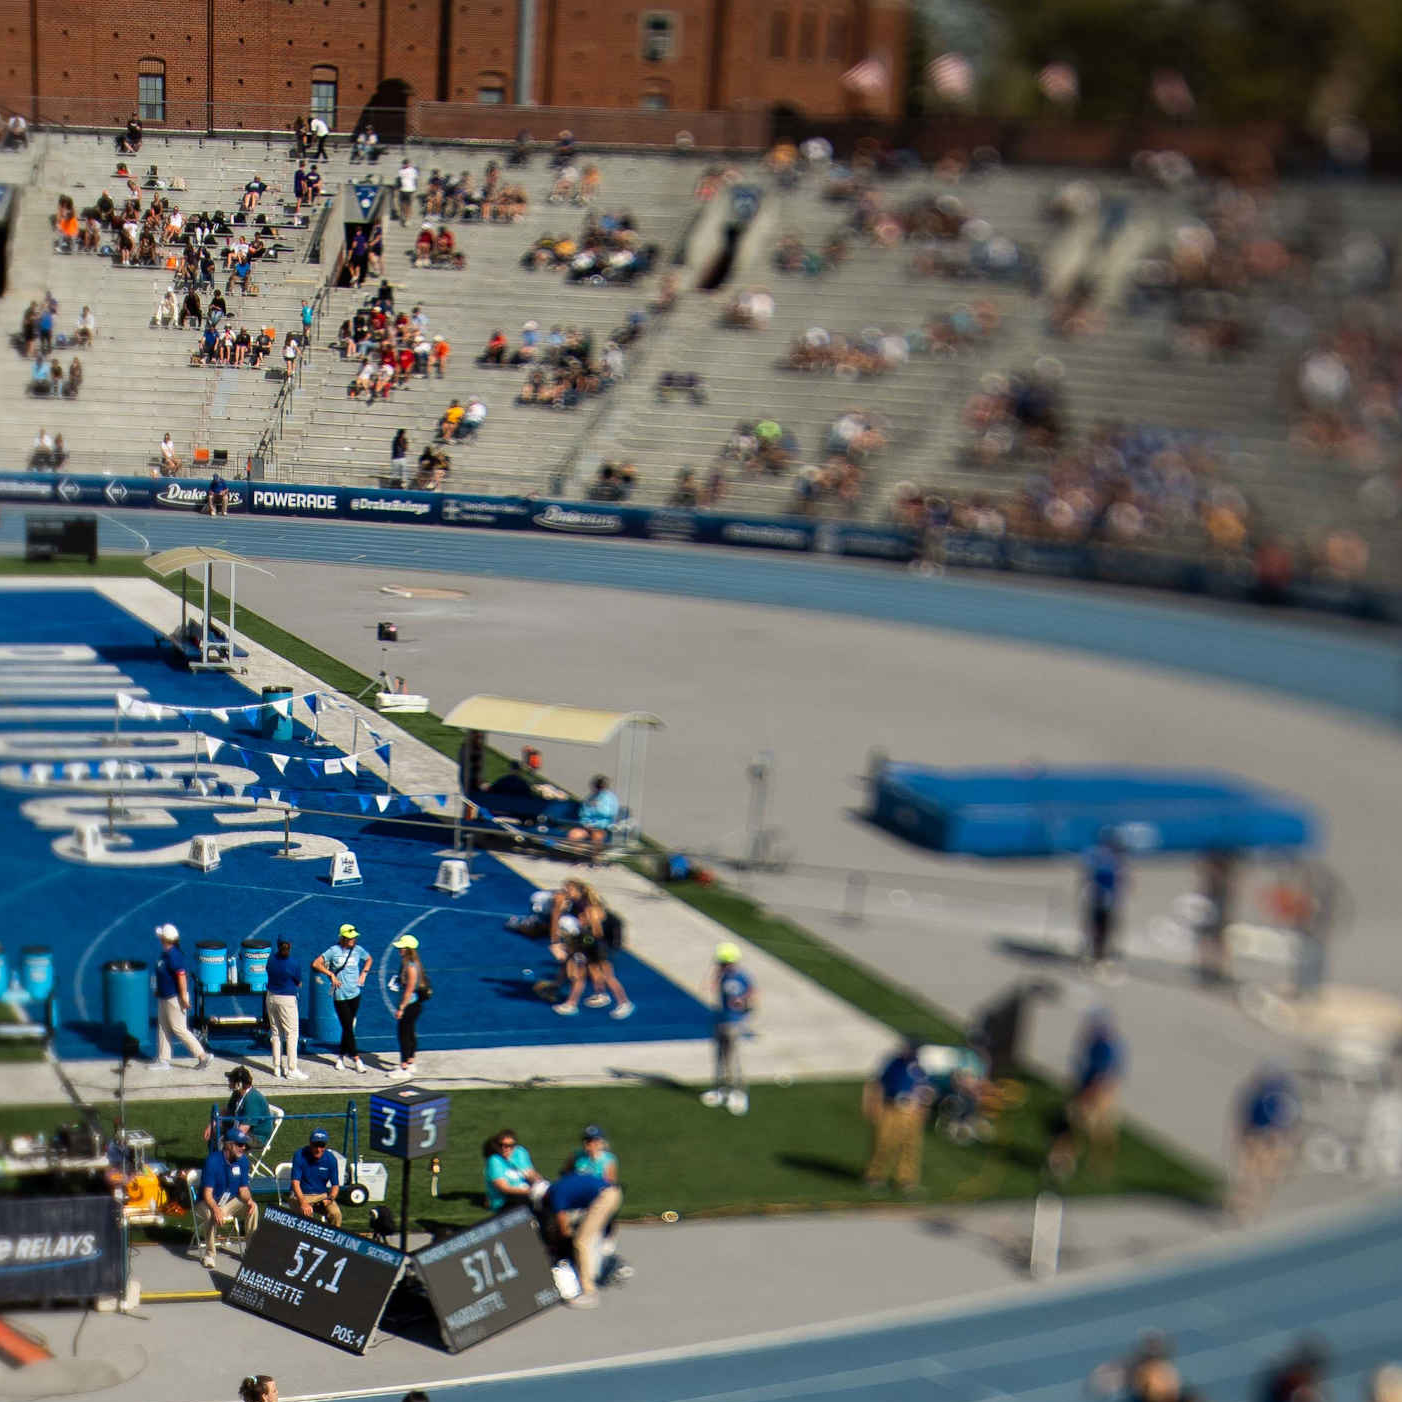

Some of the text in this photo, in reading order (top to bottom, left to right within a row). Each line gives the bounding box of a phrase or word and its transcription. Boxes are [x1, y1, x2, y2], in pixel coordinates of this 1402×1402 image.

[166, 484, 206, 501] Drake
[253, 491, 338, 510] POWERADE
[381, 1107, 397, 1147] 3
[419, 1108, 438, 1149] 3
[264, 1207, 298, 1230] WOMENS
[14, 1233, 97, 1260] RELAYS
[285, 1242, 348, 1295] 57.1
[237, 1266, 306, 1306] MARQUETTE
[331, 1324, 365, 1348] POS: 4
